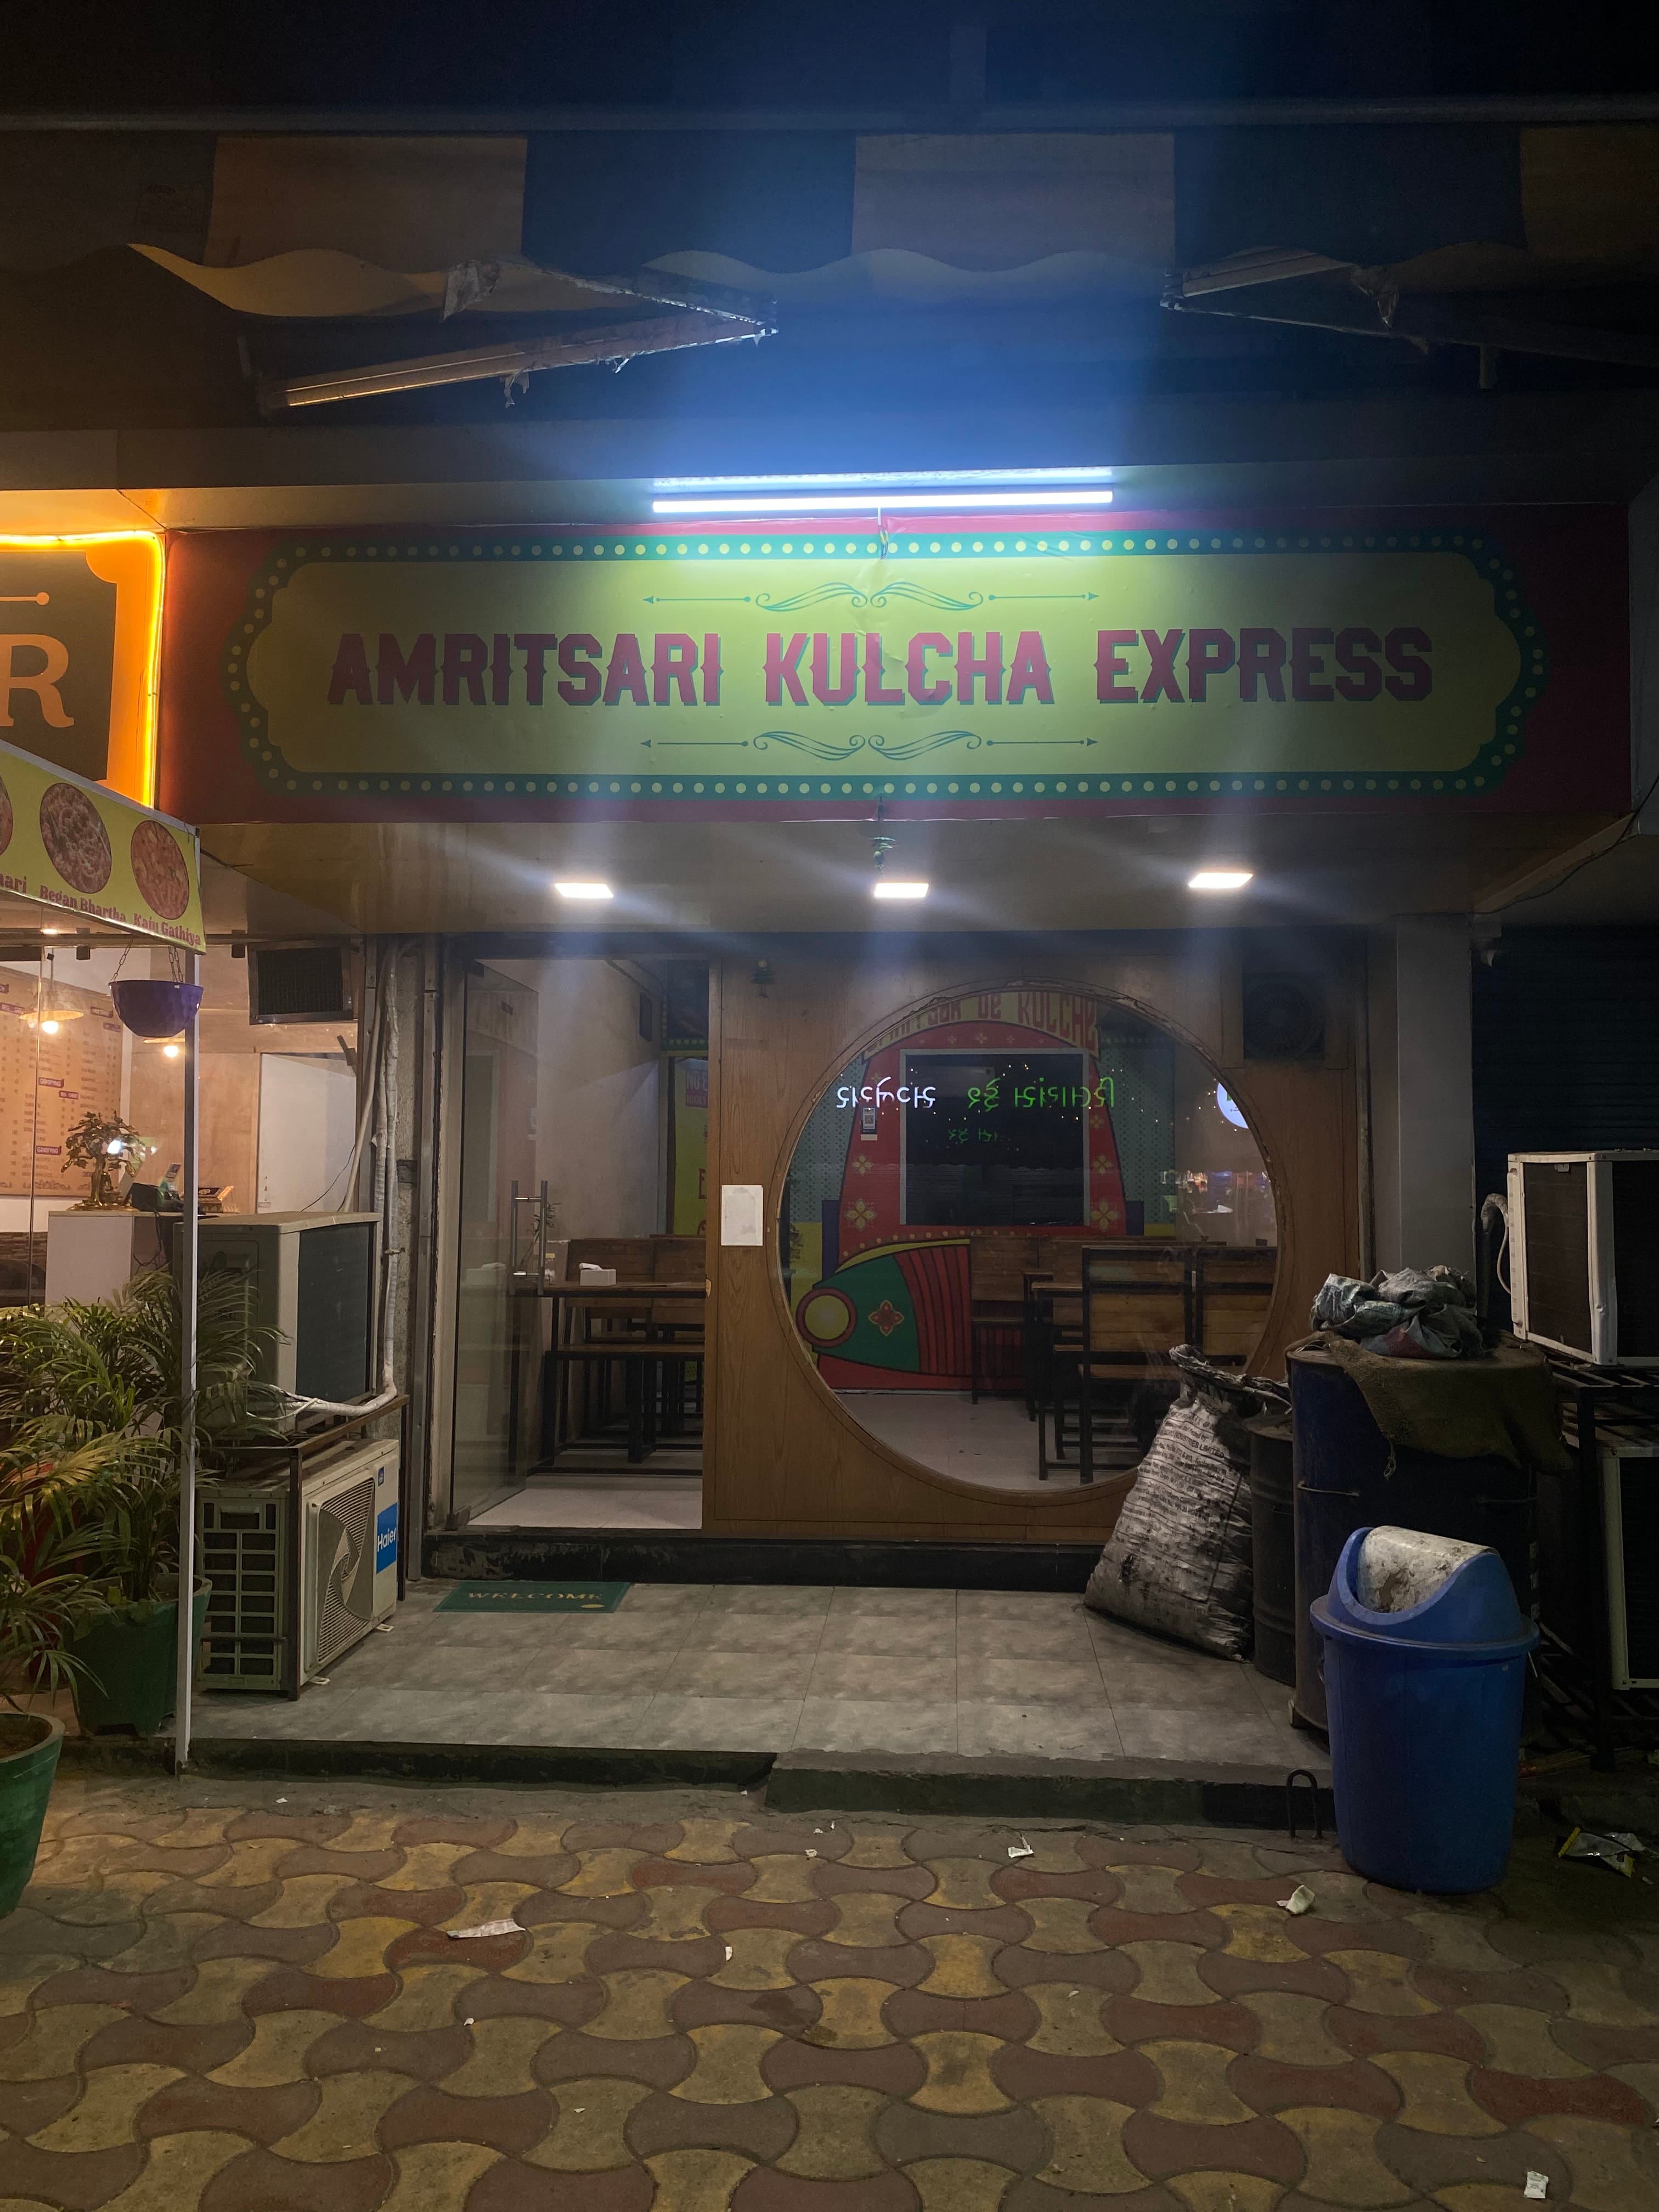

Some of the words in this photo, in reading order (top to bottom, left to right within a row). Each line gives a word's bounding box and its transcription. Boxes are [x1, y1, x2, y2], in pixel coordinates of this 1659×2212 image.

[327, 633, 724, 706] AMRITSARI
[763, 631, 1055, 706] KULCHA
[1093, 627, 1433, 703] EXPRESS
[40, 885, 78, 907] Began
[80, 898, 126, 922] Bhartha
[133, 913, 159, 932] Kaju
[161, 922, 201, 946] Gathiya
[377, 1528, 397, 1553] Haier
